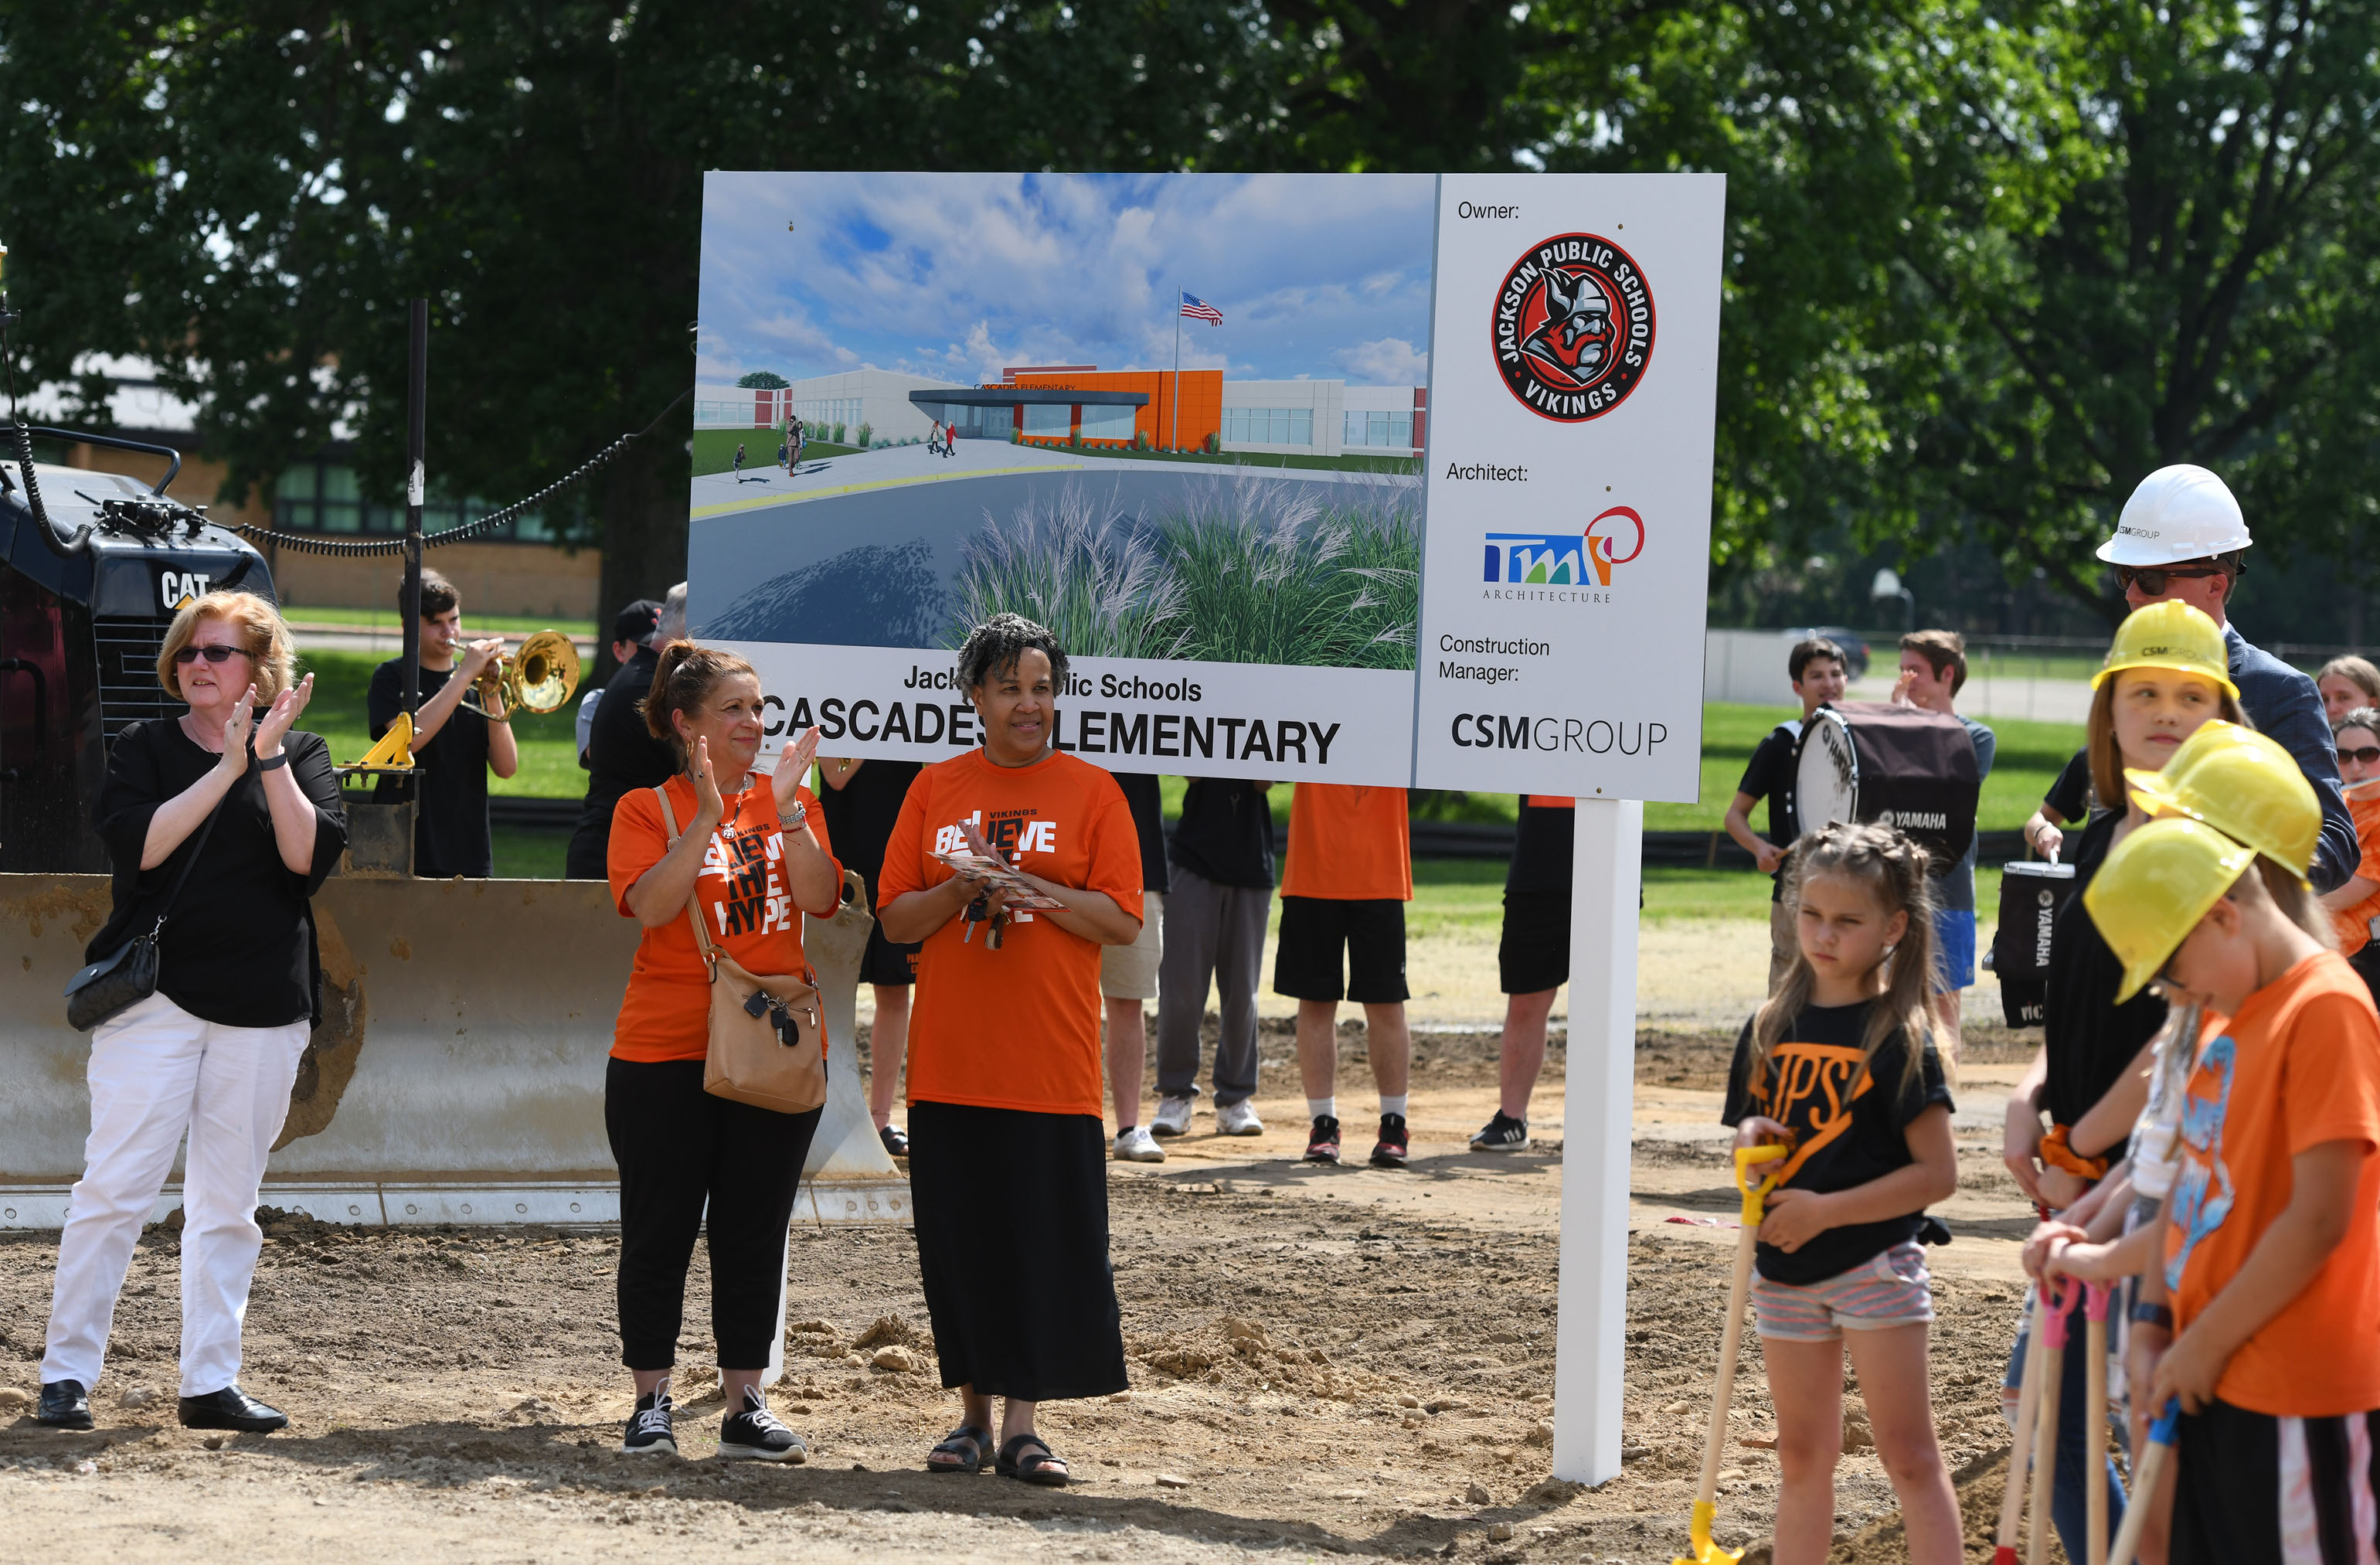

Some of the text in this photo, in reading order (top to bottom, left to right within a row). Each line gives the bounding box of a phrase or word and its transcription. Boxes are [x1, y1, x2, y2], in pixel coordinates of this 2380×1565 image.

[1458, 201, 1519, 219] Owner:
[1498, 241, 1649, 367] JACKSON PUBLIC SCHOOLS
[1525, 379, 1617, 414] VIKINGS
[1447, 462, 1528, 481] Architect:
[162, 571, 210, 609] CAT
[1483, 590, 1610, 604] ARCHITECTURE
[1440, 635, 1550, 656] Construction
[904, 665, 961, 690] Jack
[1100, 674, 1202, 702] Schools
[1439, 661, 1519, 685] Manager:
[1052, 709, 1341, 764] LEMENTARY
[1451, 713, 1668, 756] CSMGROUP
[734, 823, 770, 837] KINGS
[989, 808, 1038, 819] VIKINGS
[1896, 811, 1946, 830] YAMAHA
[699, 832, 785, 876] ELIEV
[713, 895, 792, 937] HYPE
[2036, 907, 2053, 968] YAMAHA
